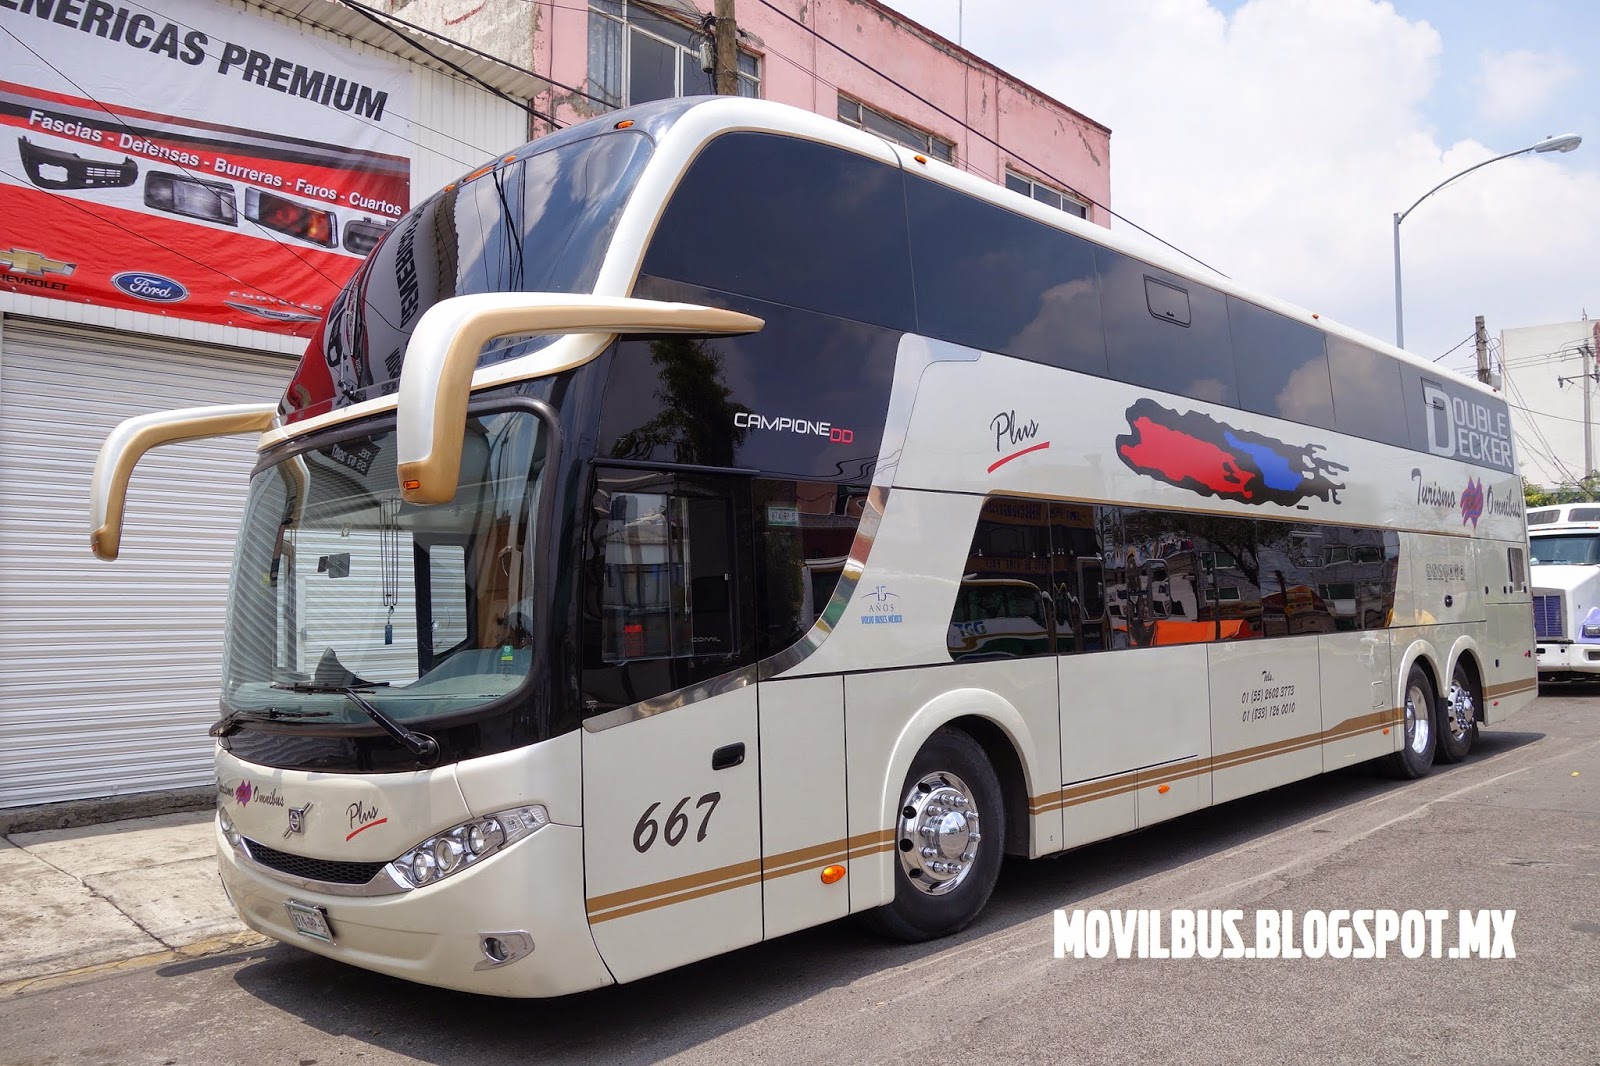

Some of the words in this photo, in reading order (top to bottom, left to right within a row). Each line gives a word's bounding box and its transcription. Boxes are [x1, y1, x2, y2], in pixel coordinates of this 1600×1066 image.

[217, 42, 389, 122] PREMIUM
[28, 109, 103, 142] Fascias
[118, 133, 200, 166] Defensas
[214, 158, 283, 187] Burreras
[295, 178, 337, 200] Faros
[349, 191, 402, 216] Cuartos
[129, 276, 173, 298] Ford
[989, 409, 1039, 451] Plus
[1411, 468, 1456, 508] Turismo
[1486, 485, 1521, 518] Omnibus
[875, 585, 887, 602] 15
[869, 602, 895, 612] AÑOS
[1241, 692, 1250, 704] 01
[1251, 689, 1264, 704] (55)
[1280, 685, 1296, 697] 3773
[1242, 710, 1250, 722] 01
[1280, 702, 1296, 715] 0010
[253, 785, 285, 807] Omnibus
[345, 802, 379, 829] Plus
[632, 791, 721, 854] 667
